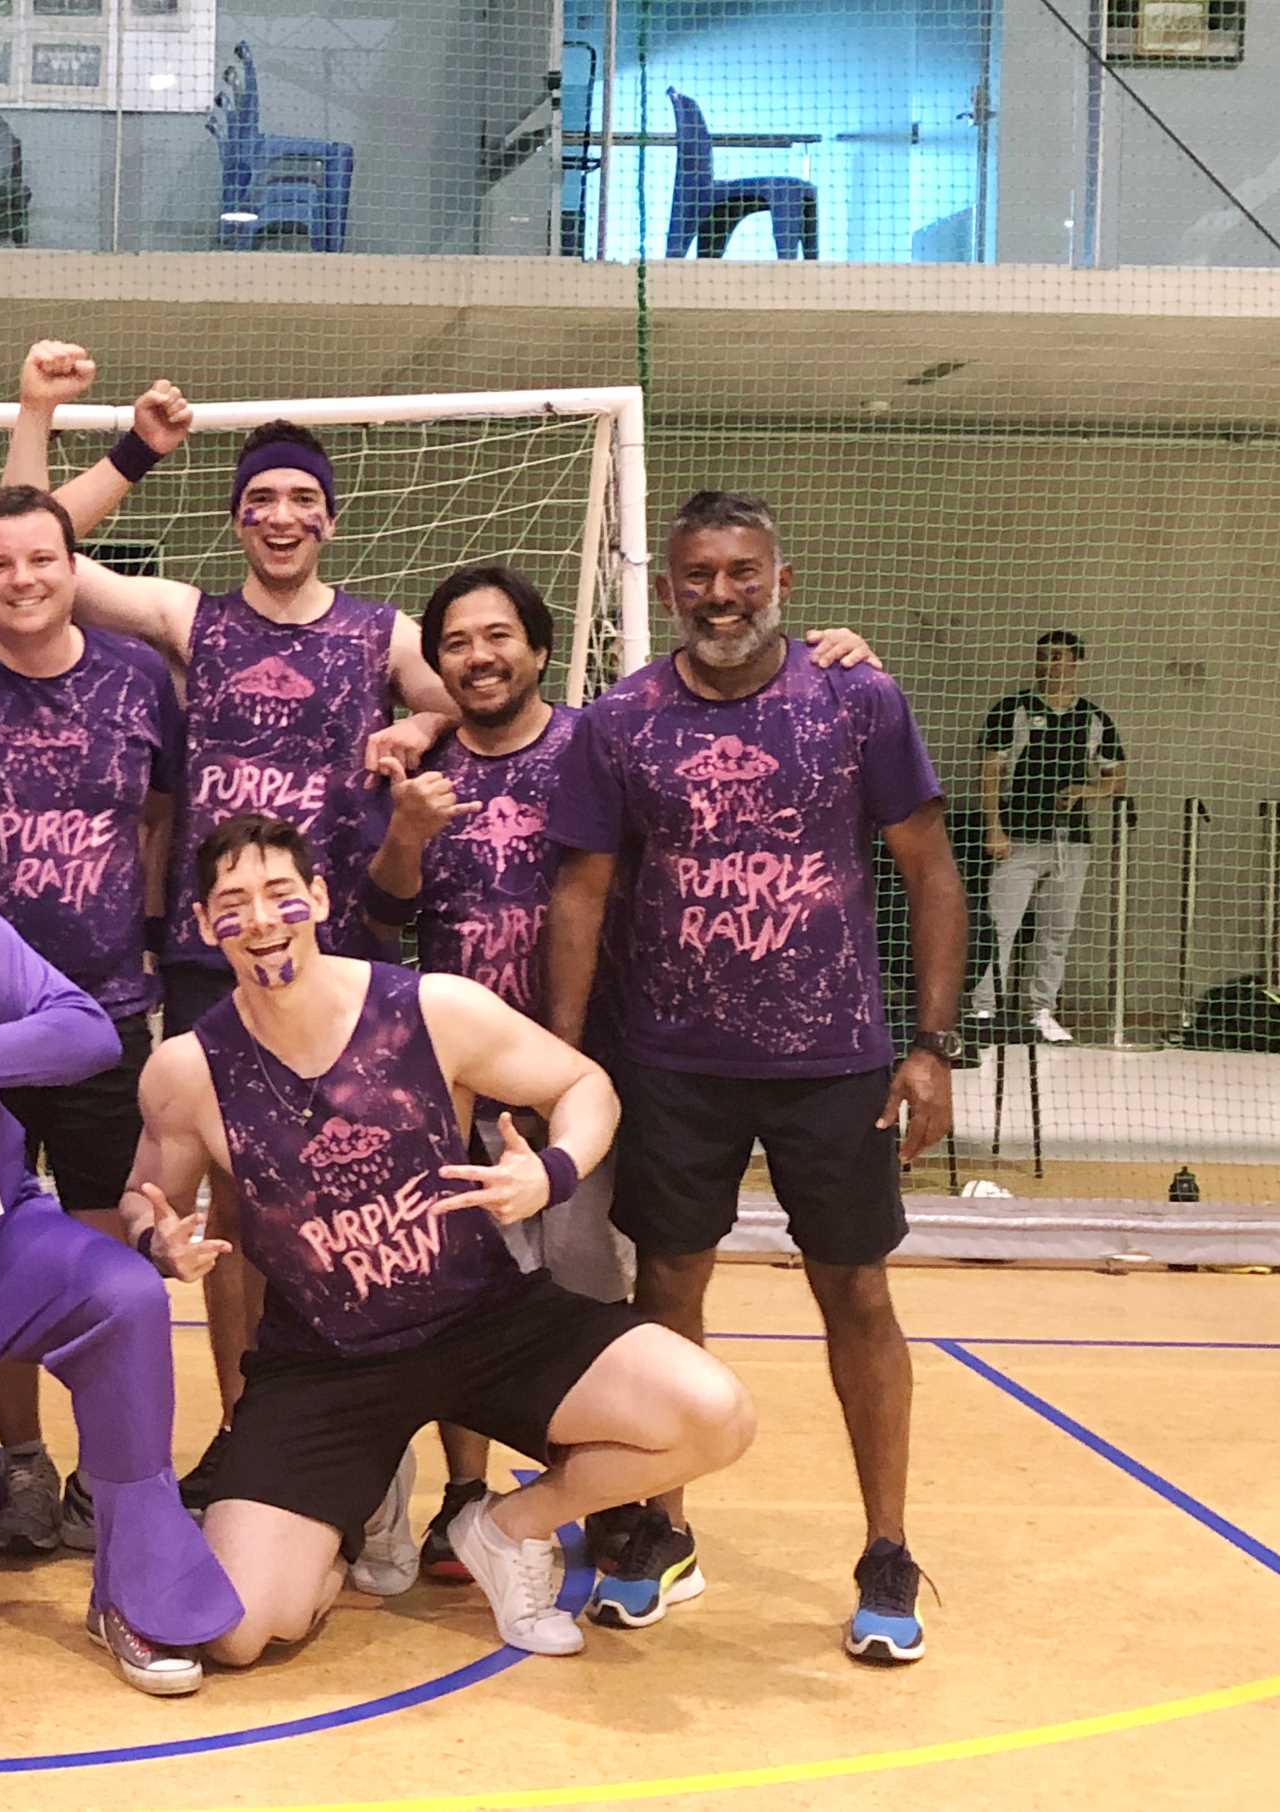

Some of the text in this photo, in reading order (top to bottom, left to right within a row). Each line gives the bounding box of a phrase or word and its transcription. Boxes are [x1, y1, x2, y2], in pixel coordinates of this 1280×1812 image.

[194, 763, 327, 809] PURPLE
[13, 843, 116, 913] RAIN
[677, 851, 833, 912] PURPLE
[298, 1169, 438, 1272] PURPLE
[342, 1211, 440, 1300] RAIN
